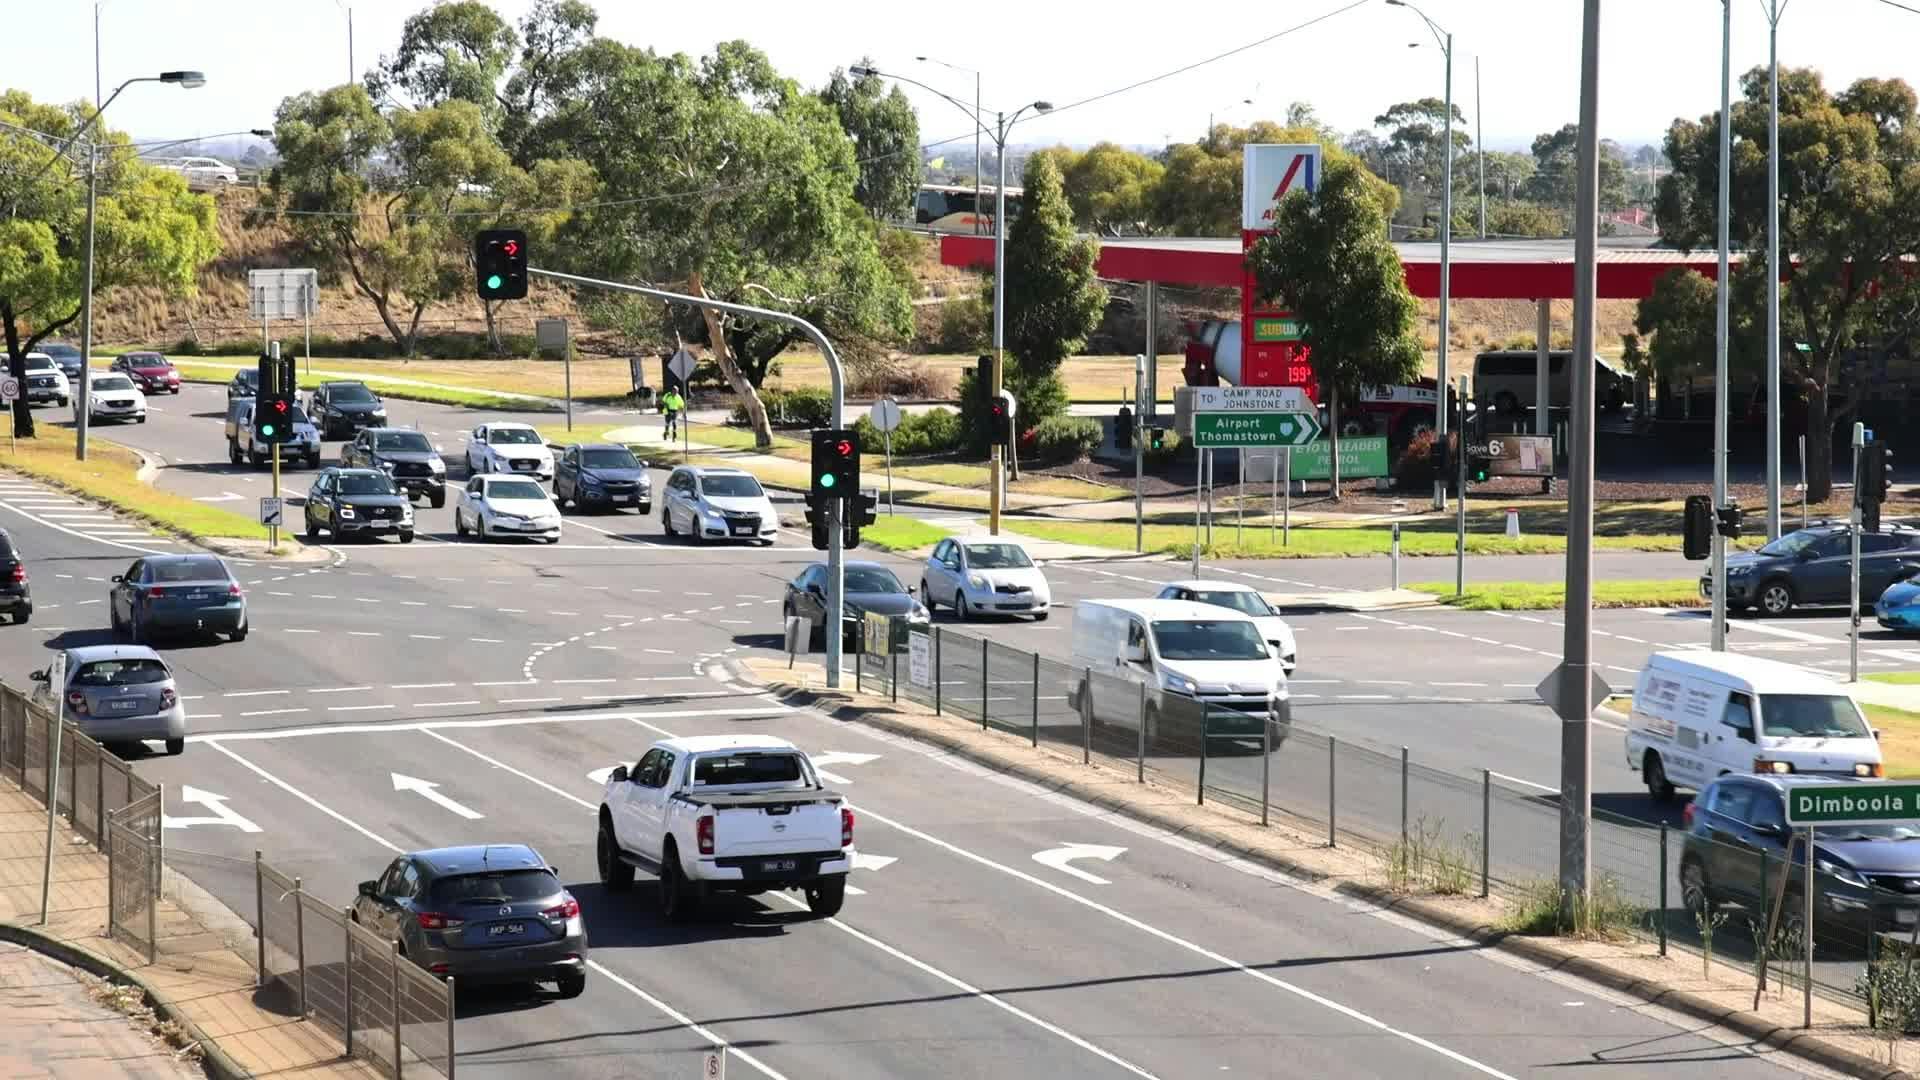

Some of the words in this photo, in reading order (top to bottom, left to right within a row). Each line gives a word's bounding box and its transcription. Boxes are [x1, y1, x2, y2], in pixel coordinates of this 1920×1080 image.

[1224, 400, 1280, 408] JOHNSTONE
[1285, 400, 1296, 408] ST
[1216, 418, 1261, 429] Airport
[1200, 432, 1276, 441] Thomastown
[1800, 795, 1904, 813] Dimboola
